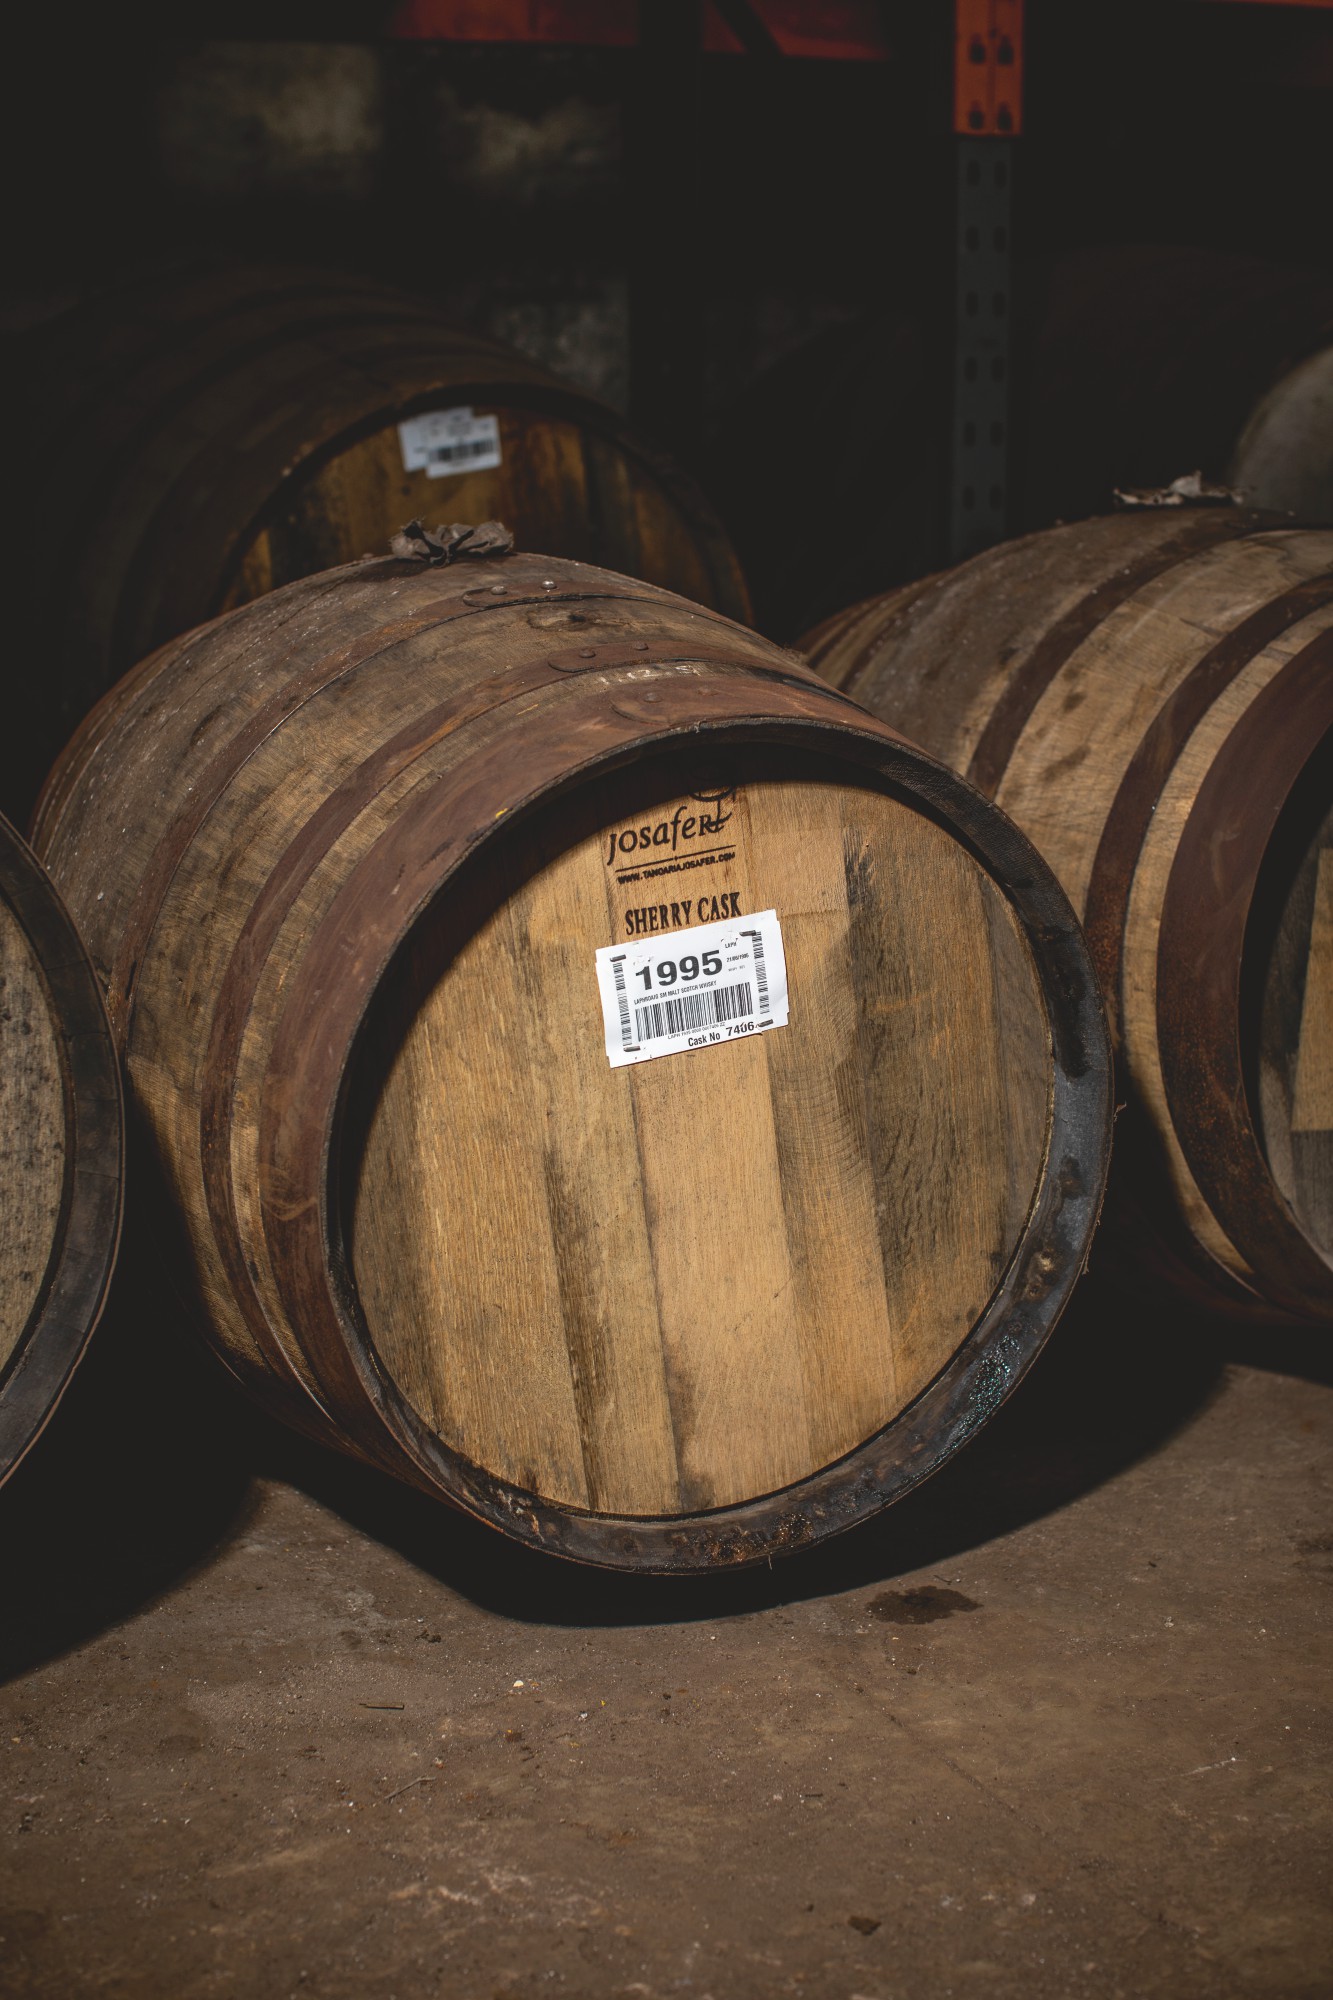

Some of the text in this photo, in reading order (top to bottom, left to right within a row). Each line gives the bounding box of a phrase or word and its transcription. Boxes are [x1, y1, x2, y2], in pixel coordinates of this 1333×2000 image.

[617, 852, 736, 884] WWW.TANOARIAJOSAFER.COM
[625, 892, 742, 935] SHERRY CASK
[635, 949, 723, 990] 1995
[681, 985, 698, 993] SCOTCH
[698, 980, 717, 989] WHISKY
[688, 1021, 755, 1047] Cask No 7406
